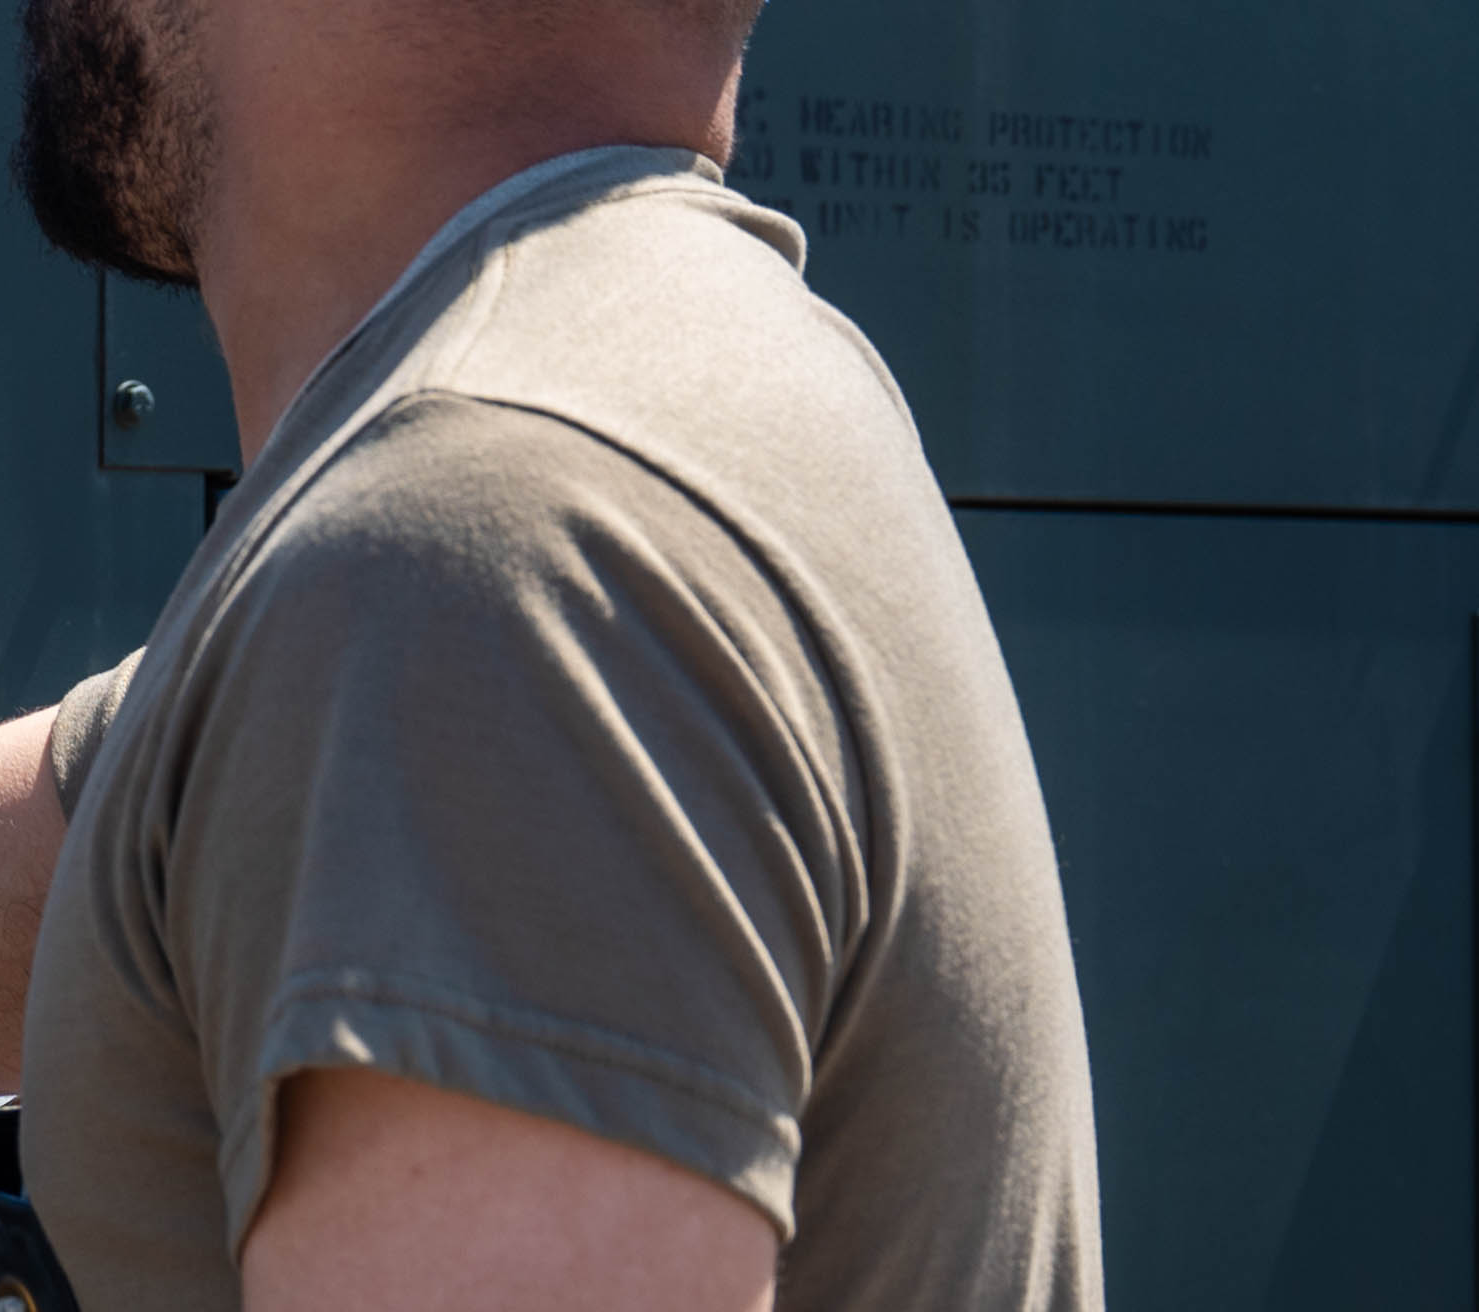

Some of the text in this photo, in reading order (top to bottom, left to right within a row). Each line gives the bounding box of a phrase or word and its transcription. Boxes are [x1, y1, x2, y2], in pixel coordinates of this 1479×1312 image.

[800, 96, 963, 142] HEARING
[988, 110, 1213, 159] PROTECTION
[800, 149, 942, 192] WITHIN
[966, 160, 1011, 195] 35
[1034, 163, 1124, 202] FEET
[820, 199, 911, 239] UNIT
[941, 203, 981, 241] IS
[1008, 209, 1208, 254] OPERATING
